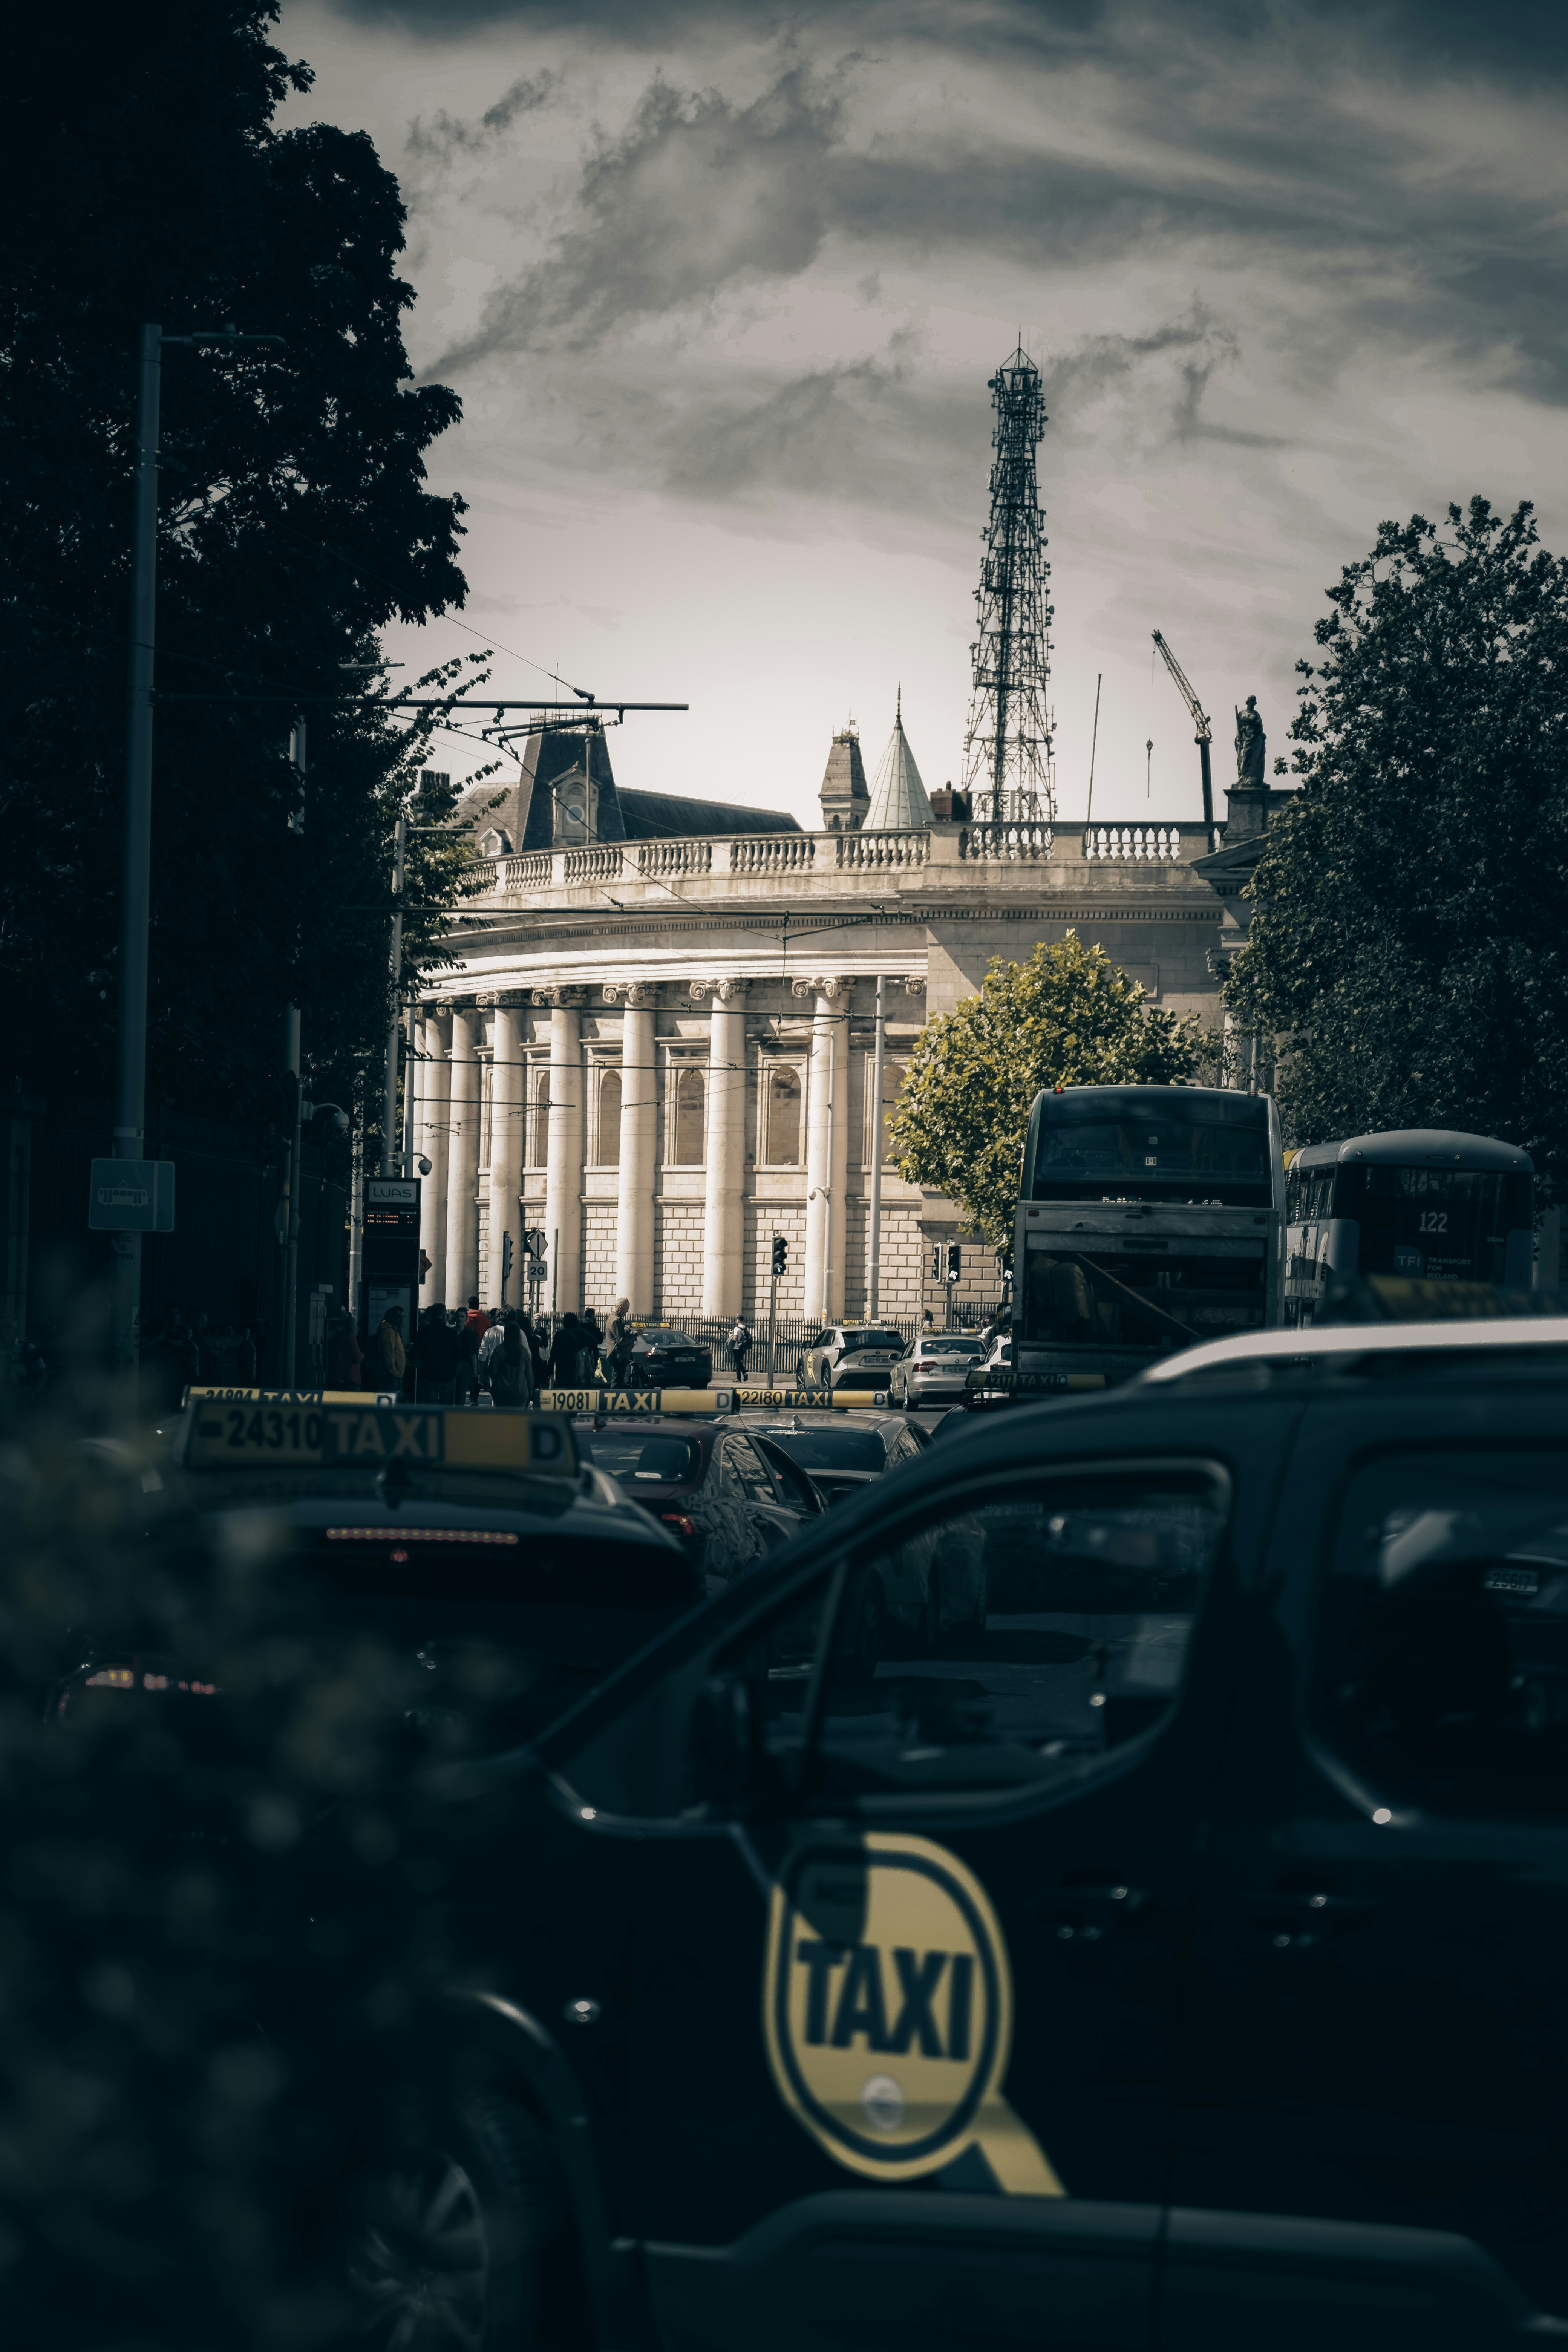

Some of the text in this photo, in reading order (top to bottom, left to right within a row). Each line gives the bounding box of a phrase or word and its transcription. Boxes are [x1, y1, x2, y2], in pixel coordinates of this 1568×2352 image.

[374, 1187, 412, 1198] LUAS
[1419, 1211, 1448, 1233] 122
[1397, 1255, 1421, 1267] TFI
[1428, 1257, 1472, 1265] TRANSPORT
[530, 1266, 545, 1275] 20
[985, 1374, 1014, 1387] 42177
[1019, 1374, 1054, 1387] TAXI
[1058, 1374, 1068, 1386] D
[552, 1392, 730, 1410] 19081 TAXI D
[741, 1390, 886, 1406] 22180 TAXI D
[227, 1409, 323, 1450] 24310
[328, 1413, 440, 1457] TAXI
[533, 1424, 561, 1459] D
[796, 1940, 974, 2061] TAXI
